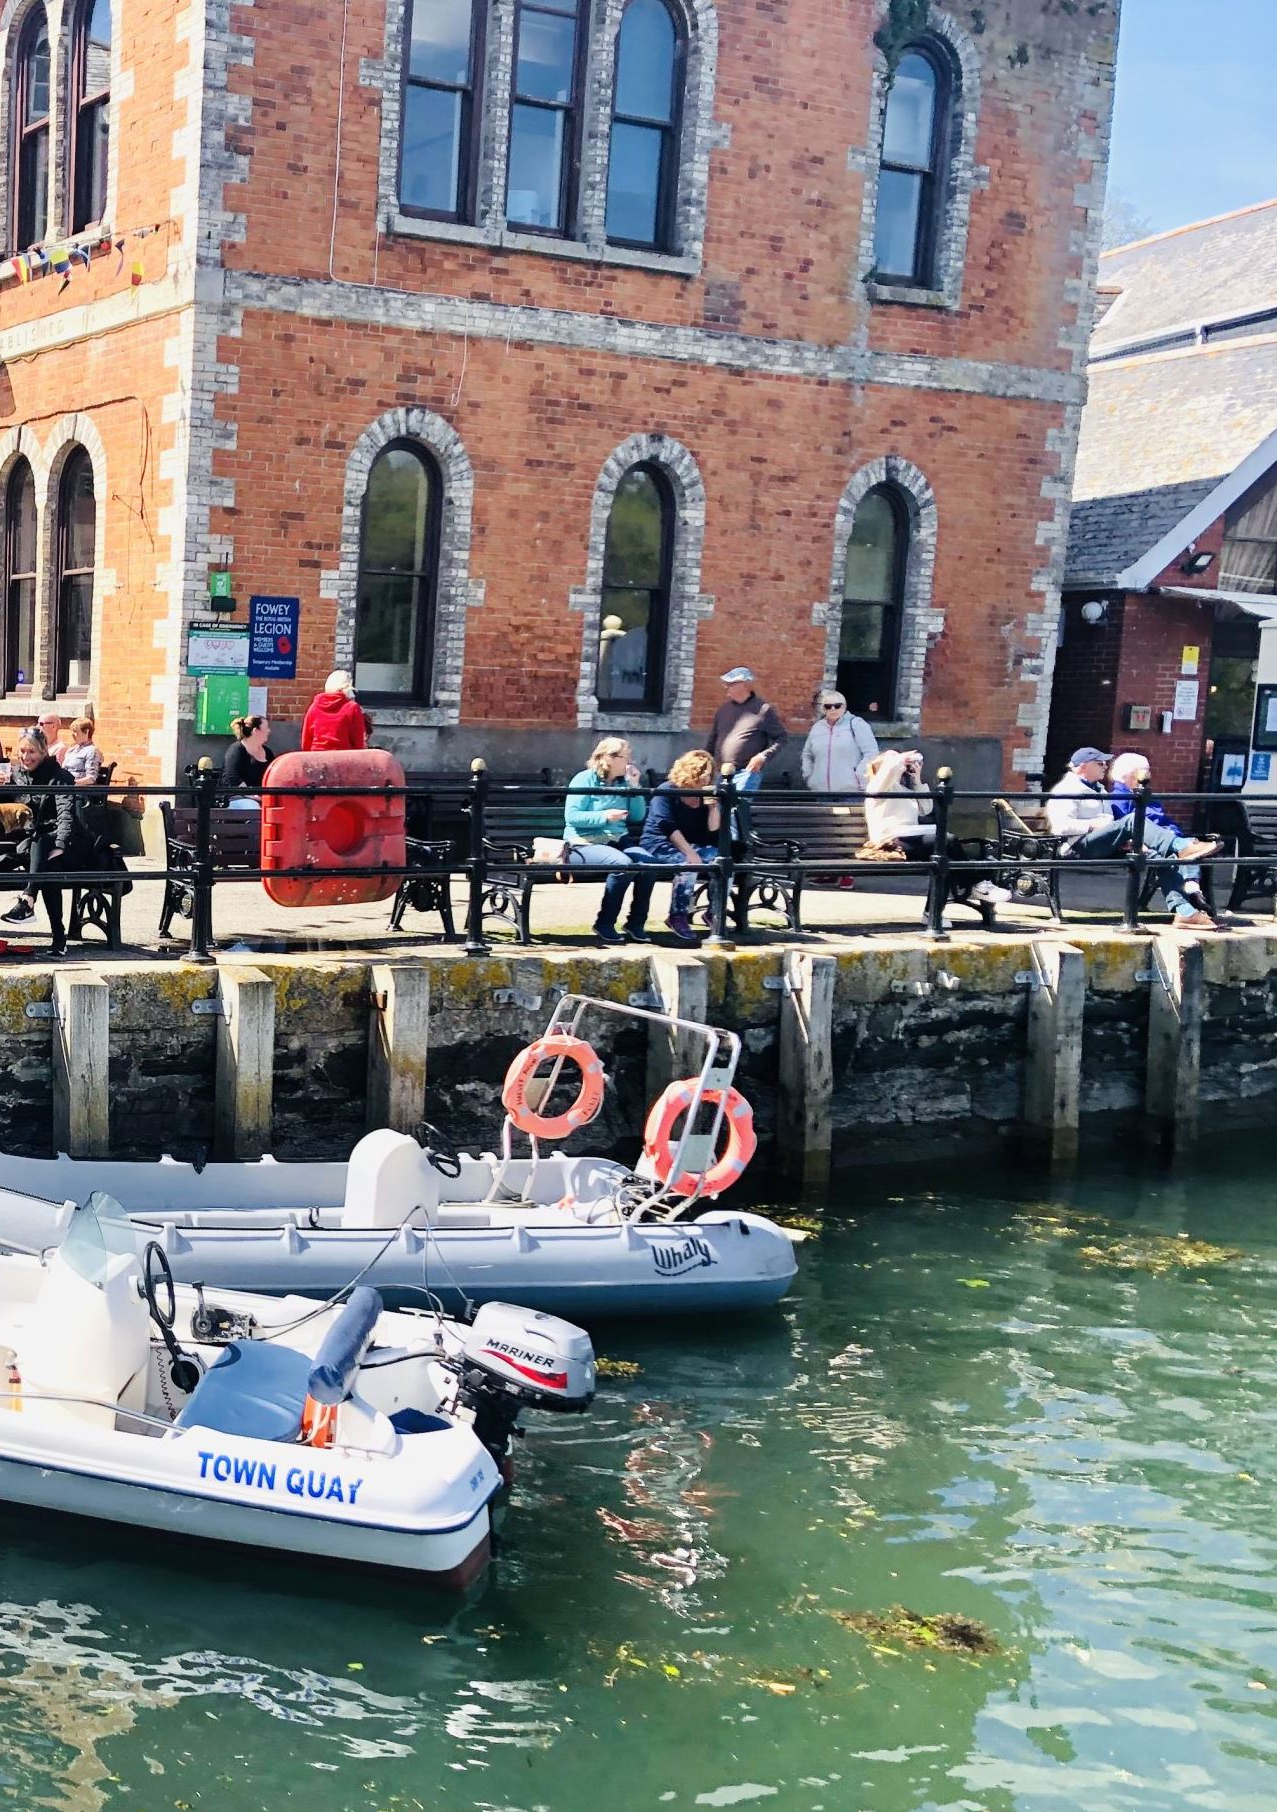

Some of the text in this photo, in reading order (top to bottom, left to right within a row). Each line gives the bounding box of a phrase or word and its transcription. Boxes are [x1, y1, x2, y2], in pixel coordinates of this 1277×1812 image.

[255, 603, 290, 615] FOWEY
[254, 623, 292, 635] LEGION
[651, 1236, 712, 1270] Whaly
[486, 1338, 555, 1368] MARINER
[197, 1450, 365, 1505] TOWN QUAY
